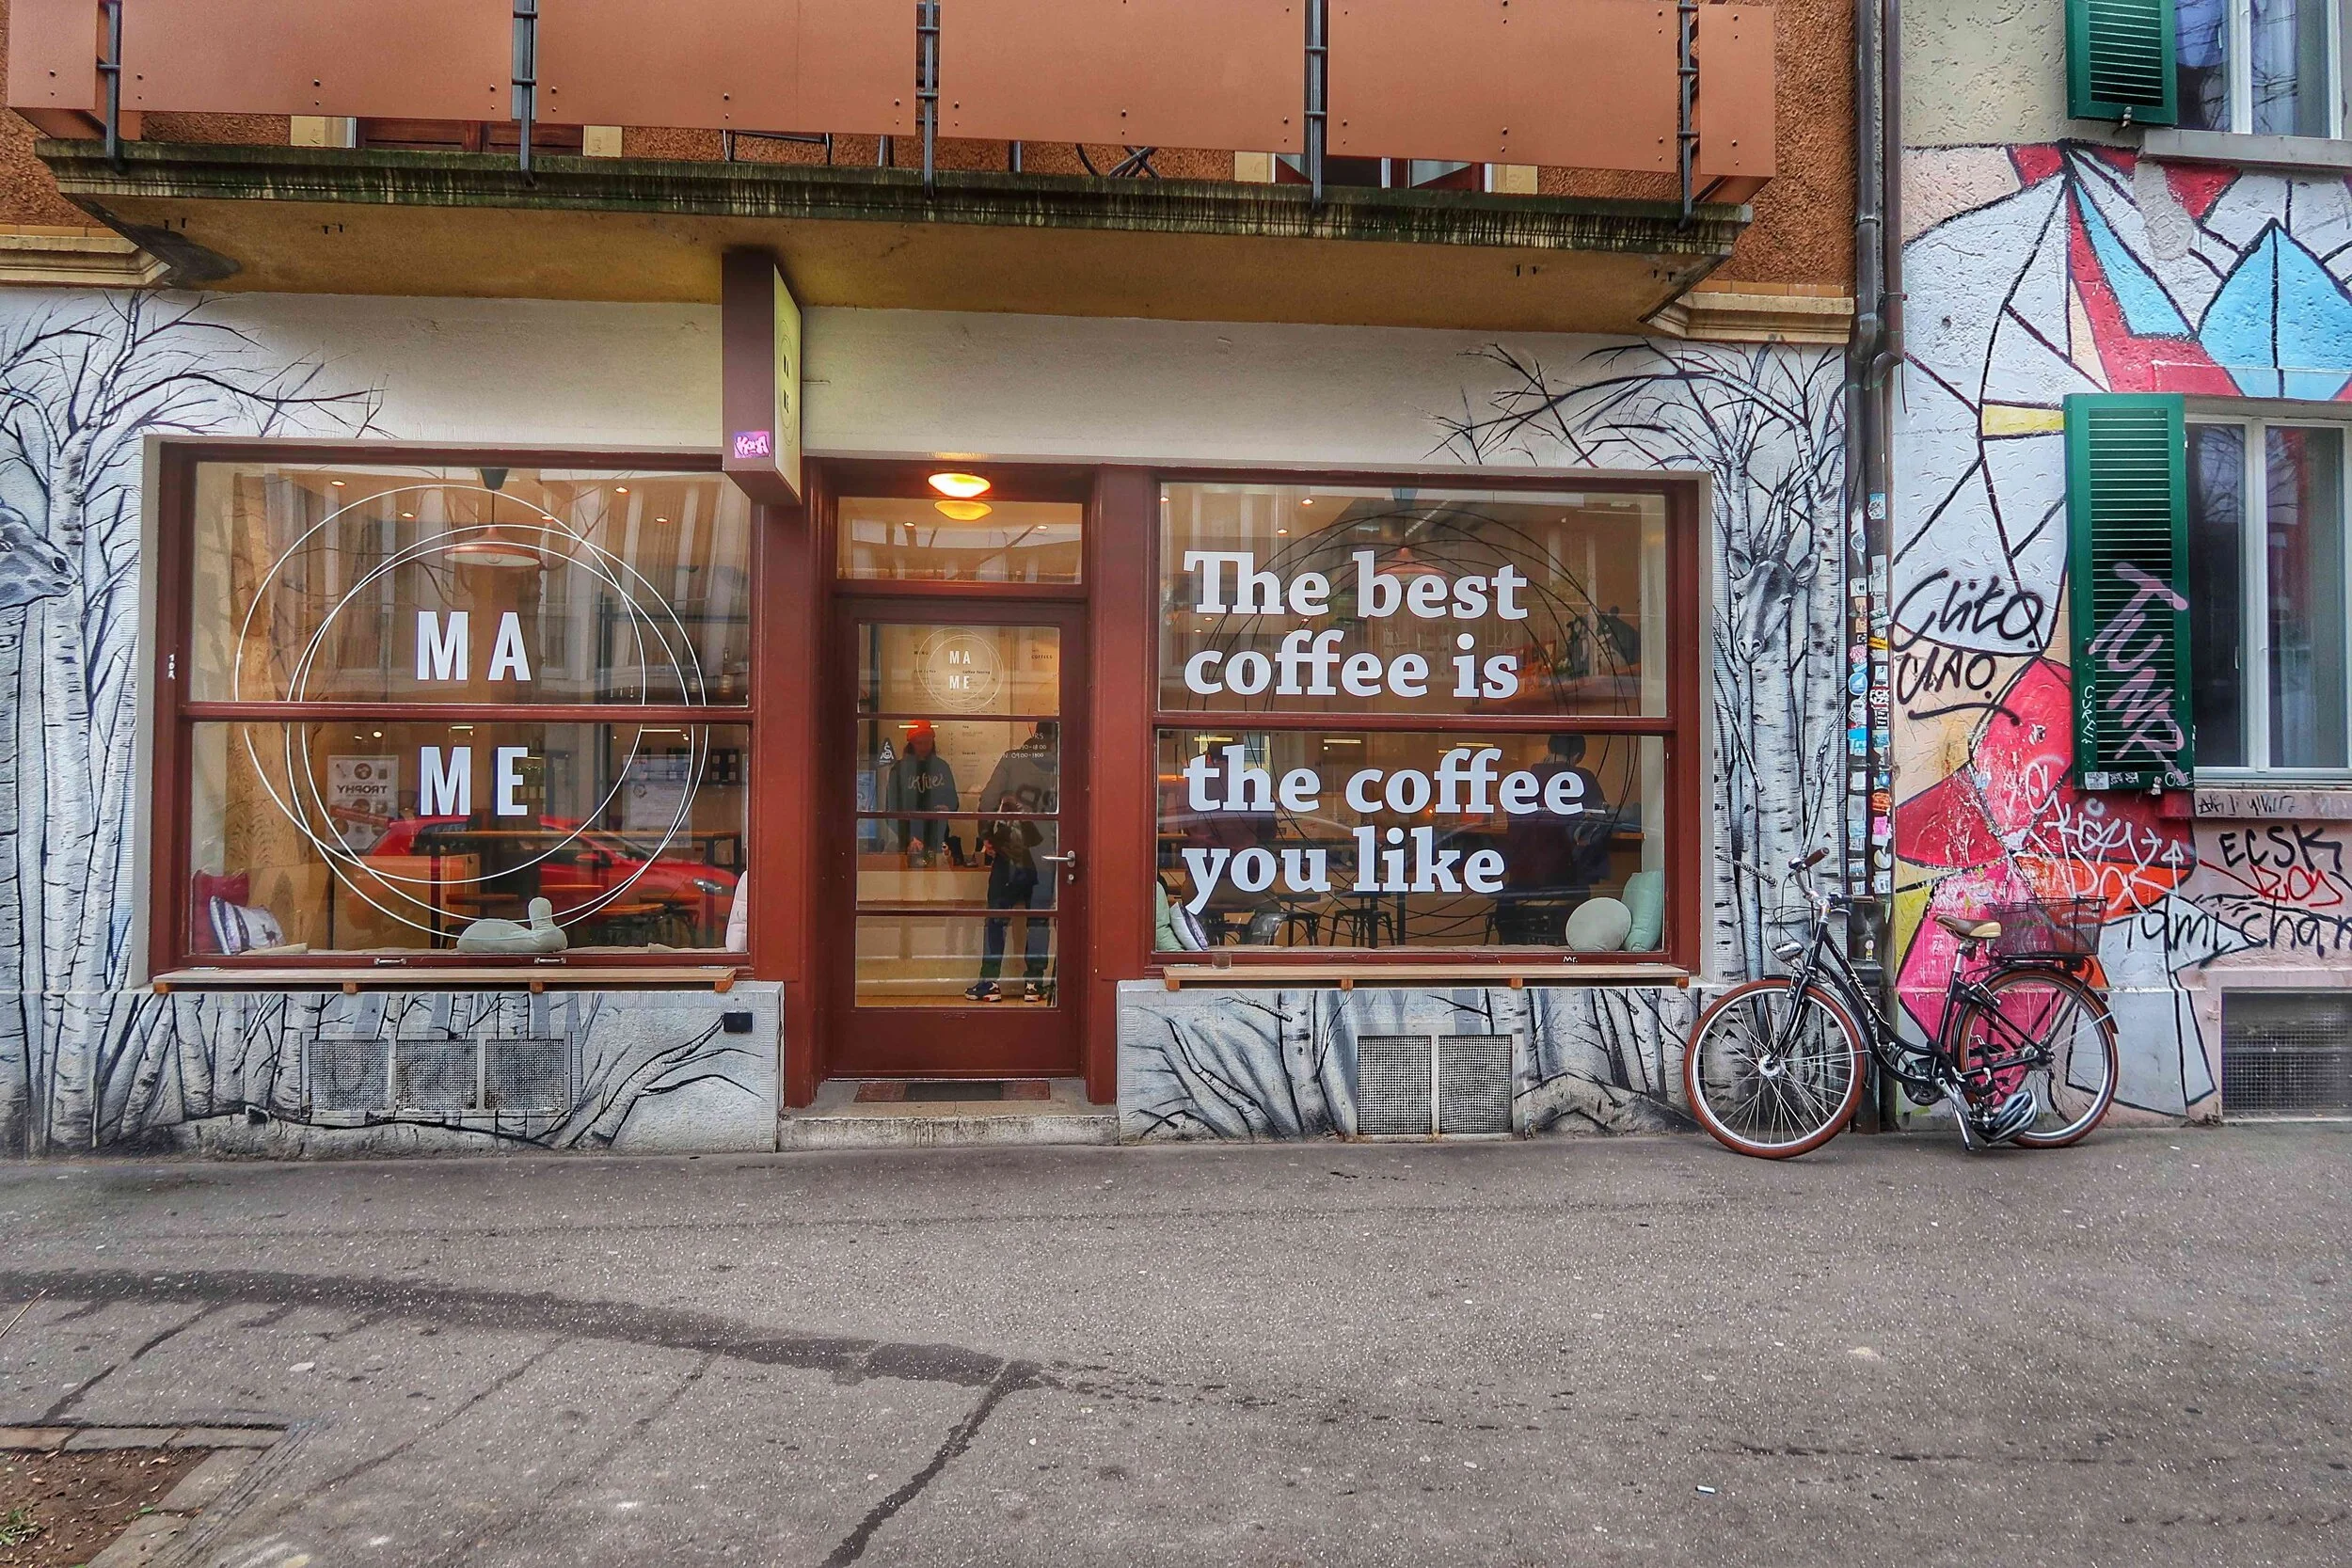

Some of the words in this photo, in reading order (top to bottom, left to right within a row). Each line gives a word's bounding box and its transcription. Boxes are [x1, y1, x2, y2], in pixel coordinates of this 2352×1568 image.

[1184, 550, 1330, 615] The
[1352, 550, 1528, 621] best
[416, 610, 532, 682] MA
[949, 650, 971, 664] MA
[1184, 629, 1430, 697] coffee
[1452, 632, 1519, 699] is
[949, 675, 970, 689] ME
[419, 746, 529, 816] ME
[1184, 744, 1321, 812] the
[1345, 747, 1585, 815] coffee
[1182, 846, 1331, 915] you
[1352, 825, 1505, 893] like
